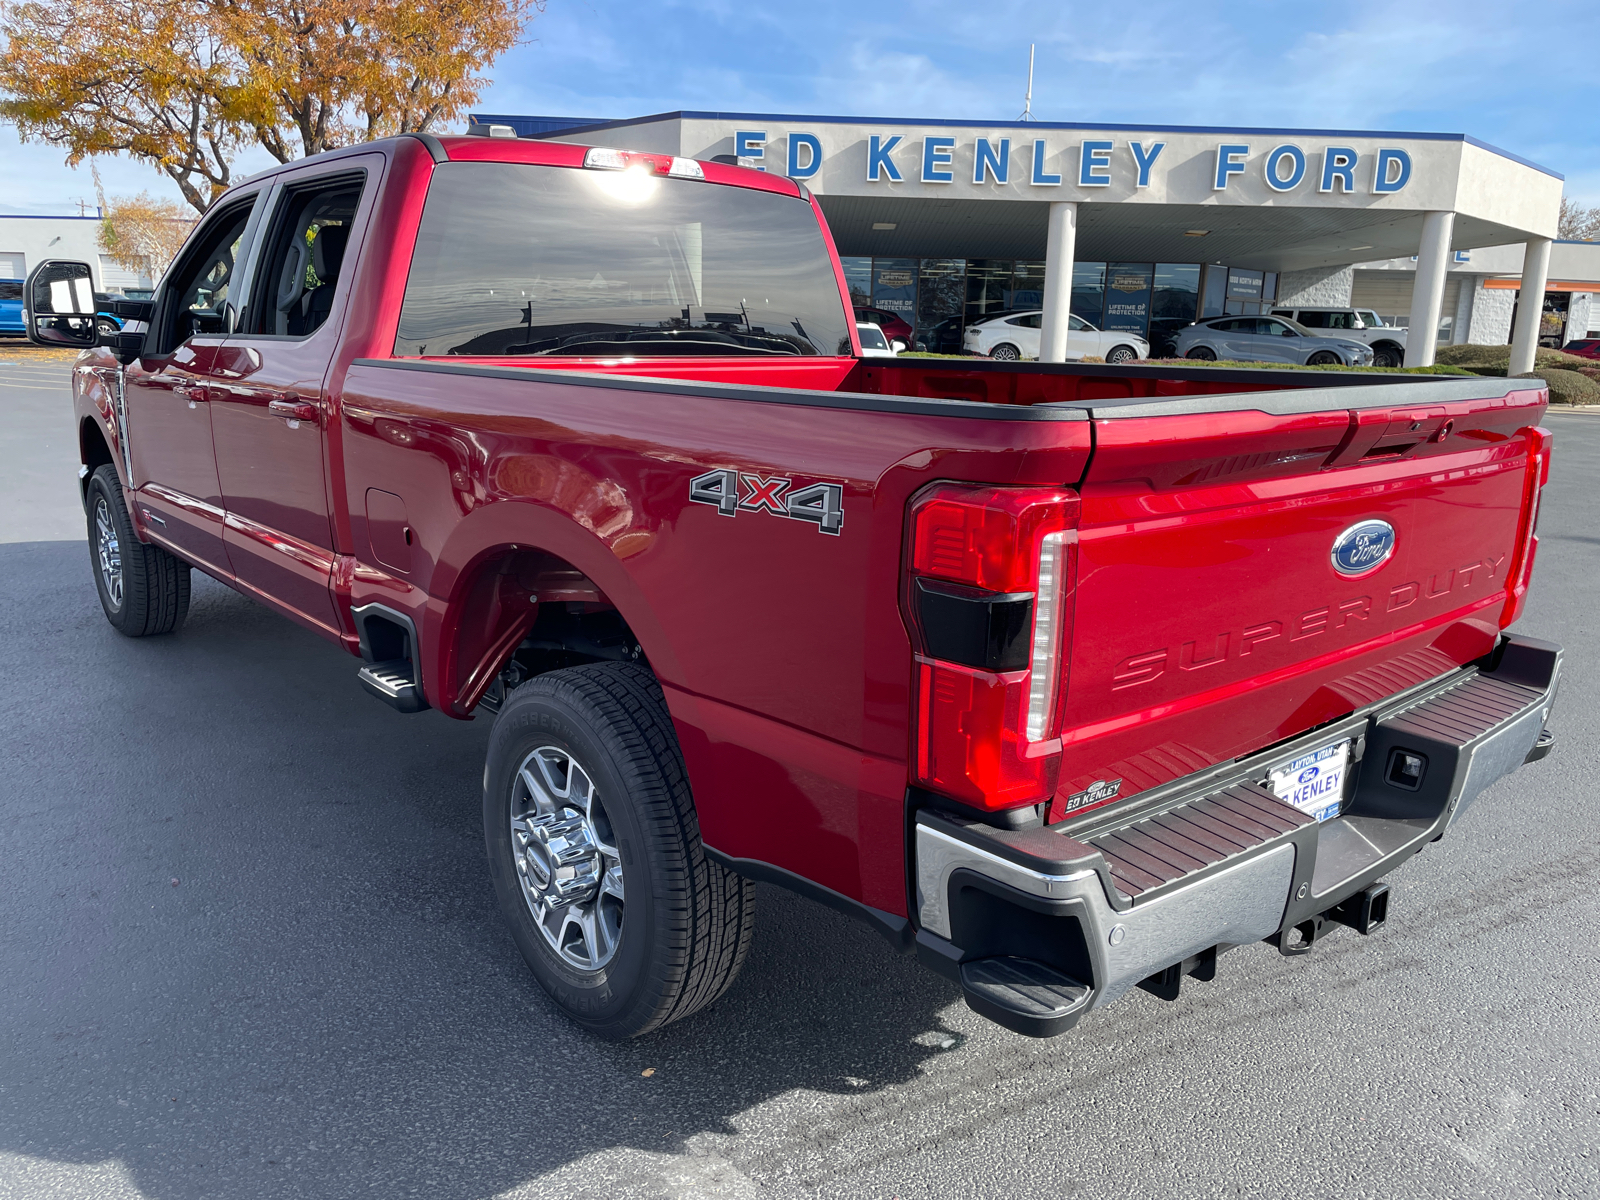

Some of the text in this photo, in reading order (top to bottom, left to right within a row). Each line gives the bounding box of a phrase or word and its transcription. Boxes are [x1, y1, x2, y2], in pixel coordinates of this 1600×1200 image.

[734, 130, 1413, 195] ED KENLEY FORD
[1112, 552, 1506, 691] SUPER DUTY
[498, 711, 561, 748] GRABBER
[1290, 746, 1334, 770] LAYTON, UTAH
[1066, 797, 1081, 810] ED
[1082, 783, 1121, 805] KENLEY
[1293, 771, 1342, 806] KENLEY
